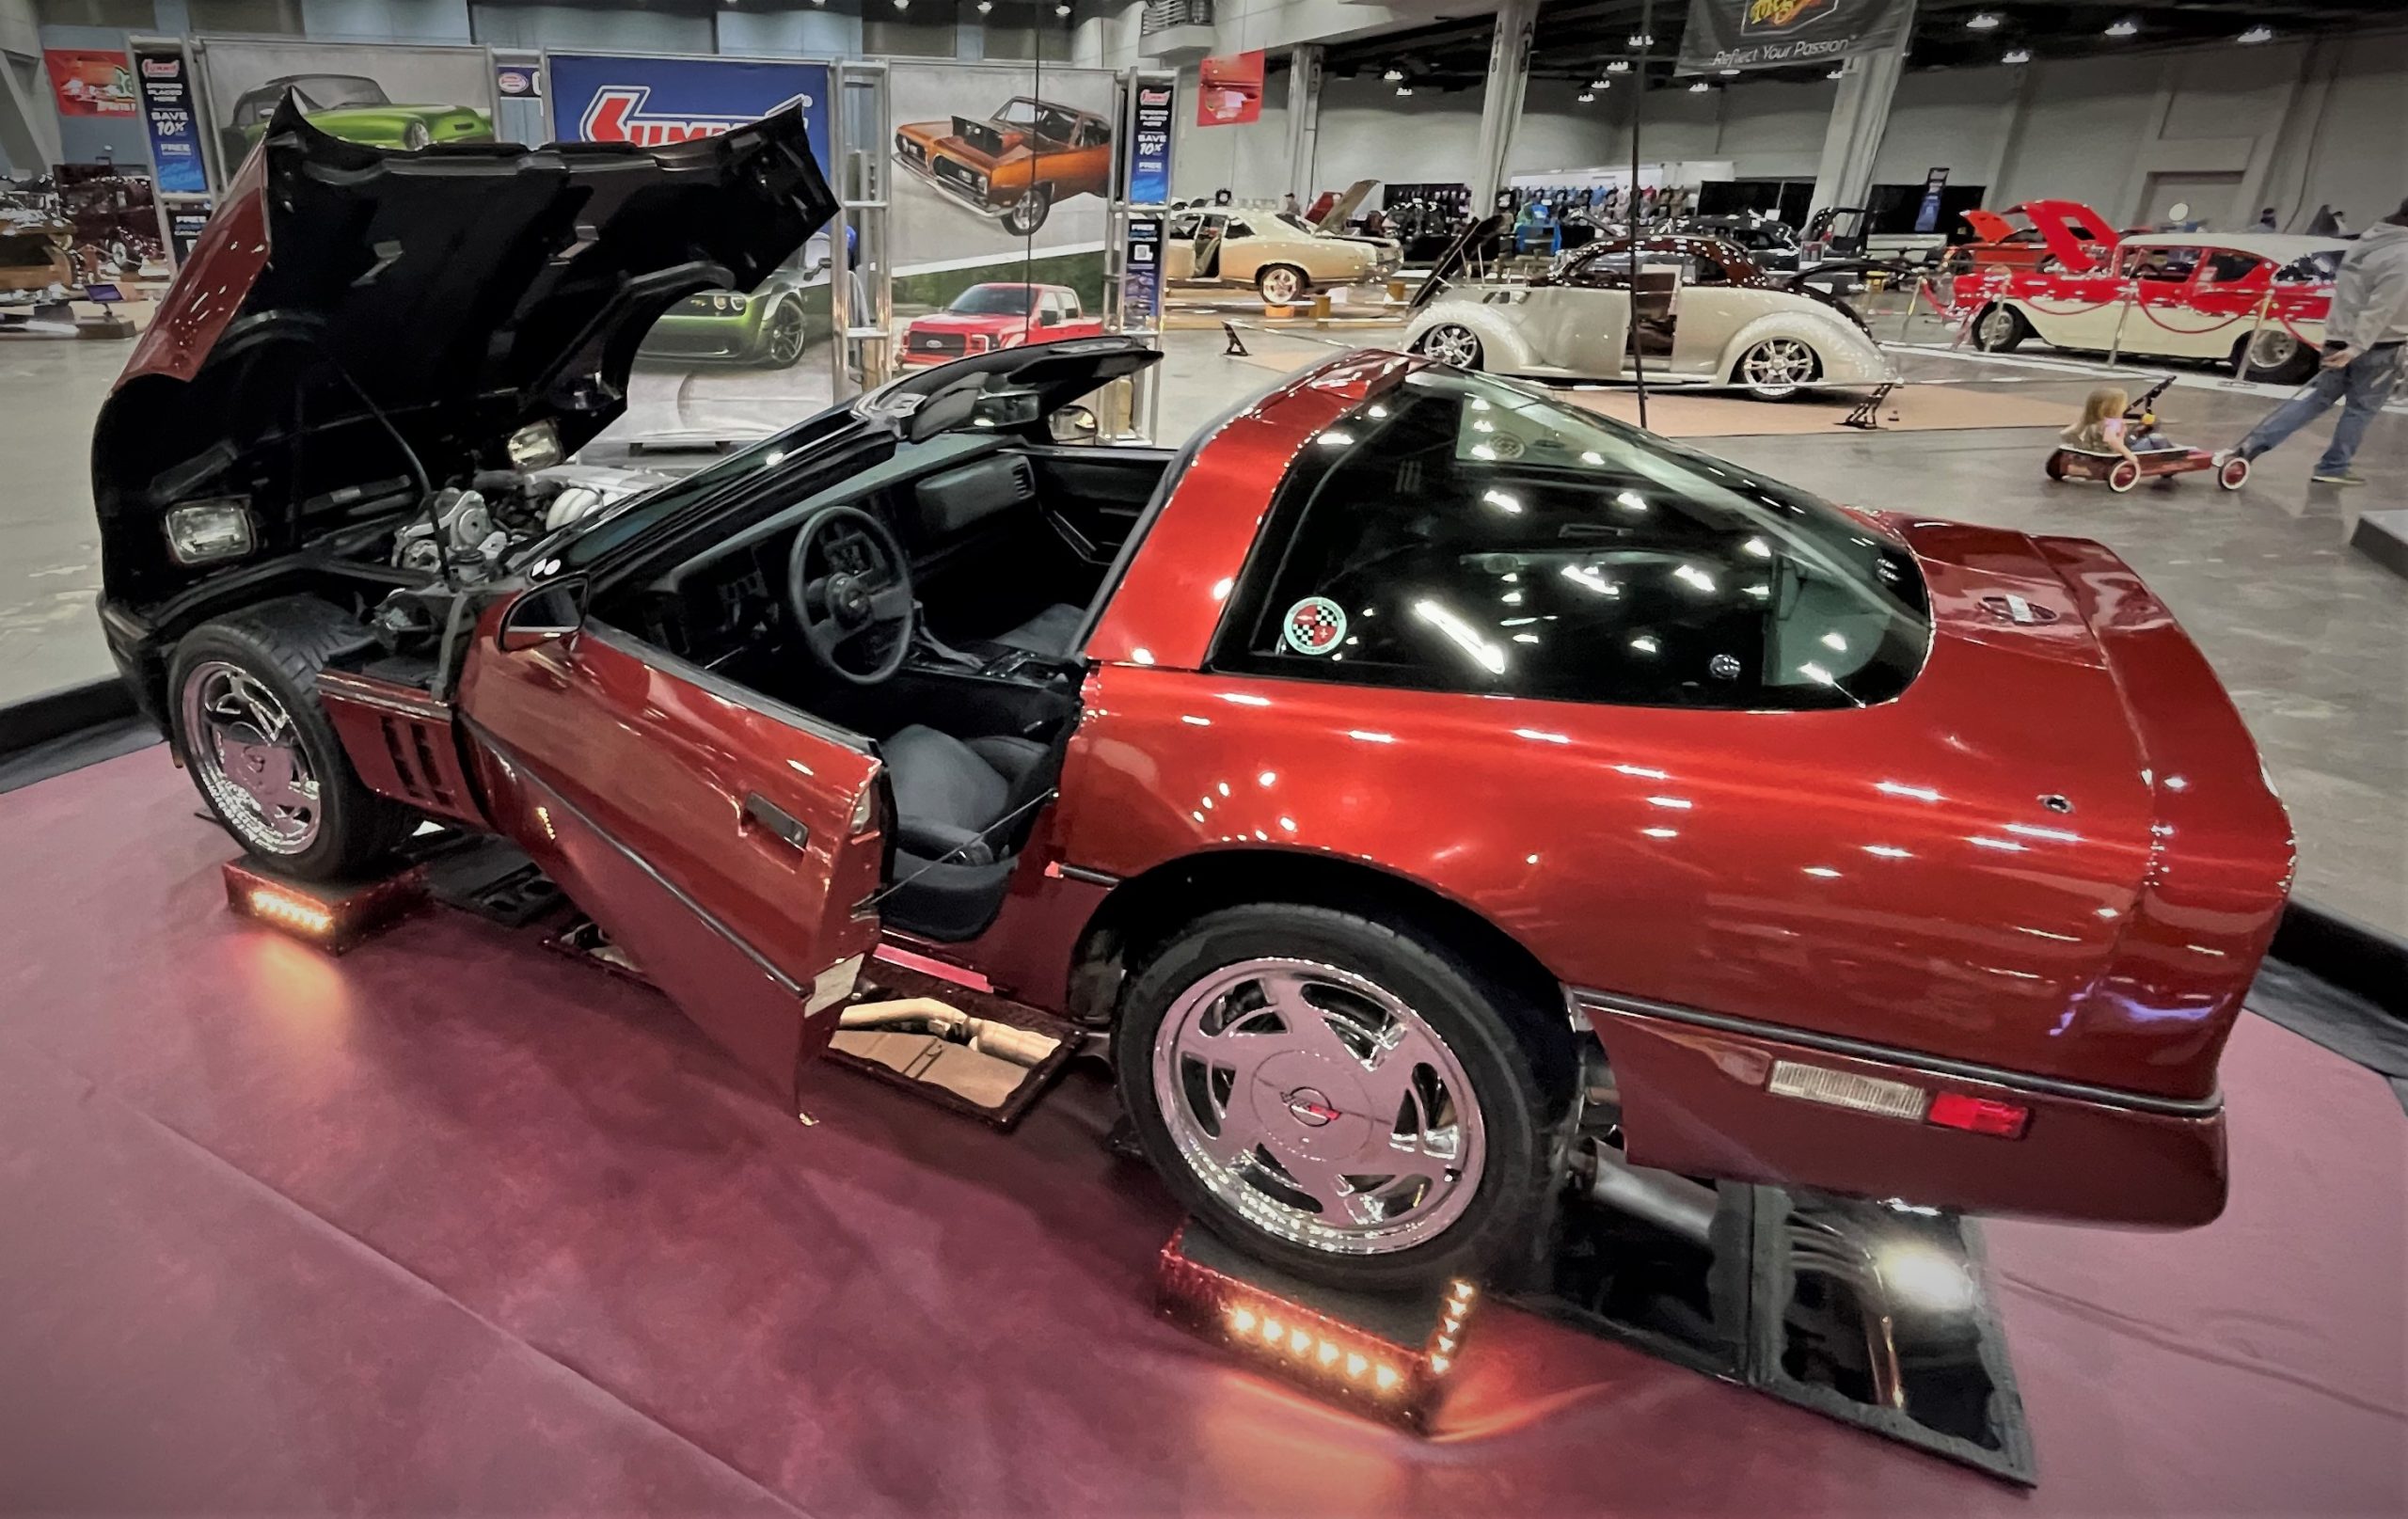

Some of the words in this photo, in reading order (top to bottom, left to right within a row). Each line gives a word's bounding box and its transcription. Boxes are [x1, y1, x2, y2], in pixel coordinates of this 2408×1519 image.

[1763, 44, 1790, 60] Your
[1794, 39, 1849, 57] Passion
[150, 111, 189, 121] SAVE
[579, 86, 805, 148] SUM
[156, 120, 186, 136] 10%
[1139, 142, 1164, 155] 10%
